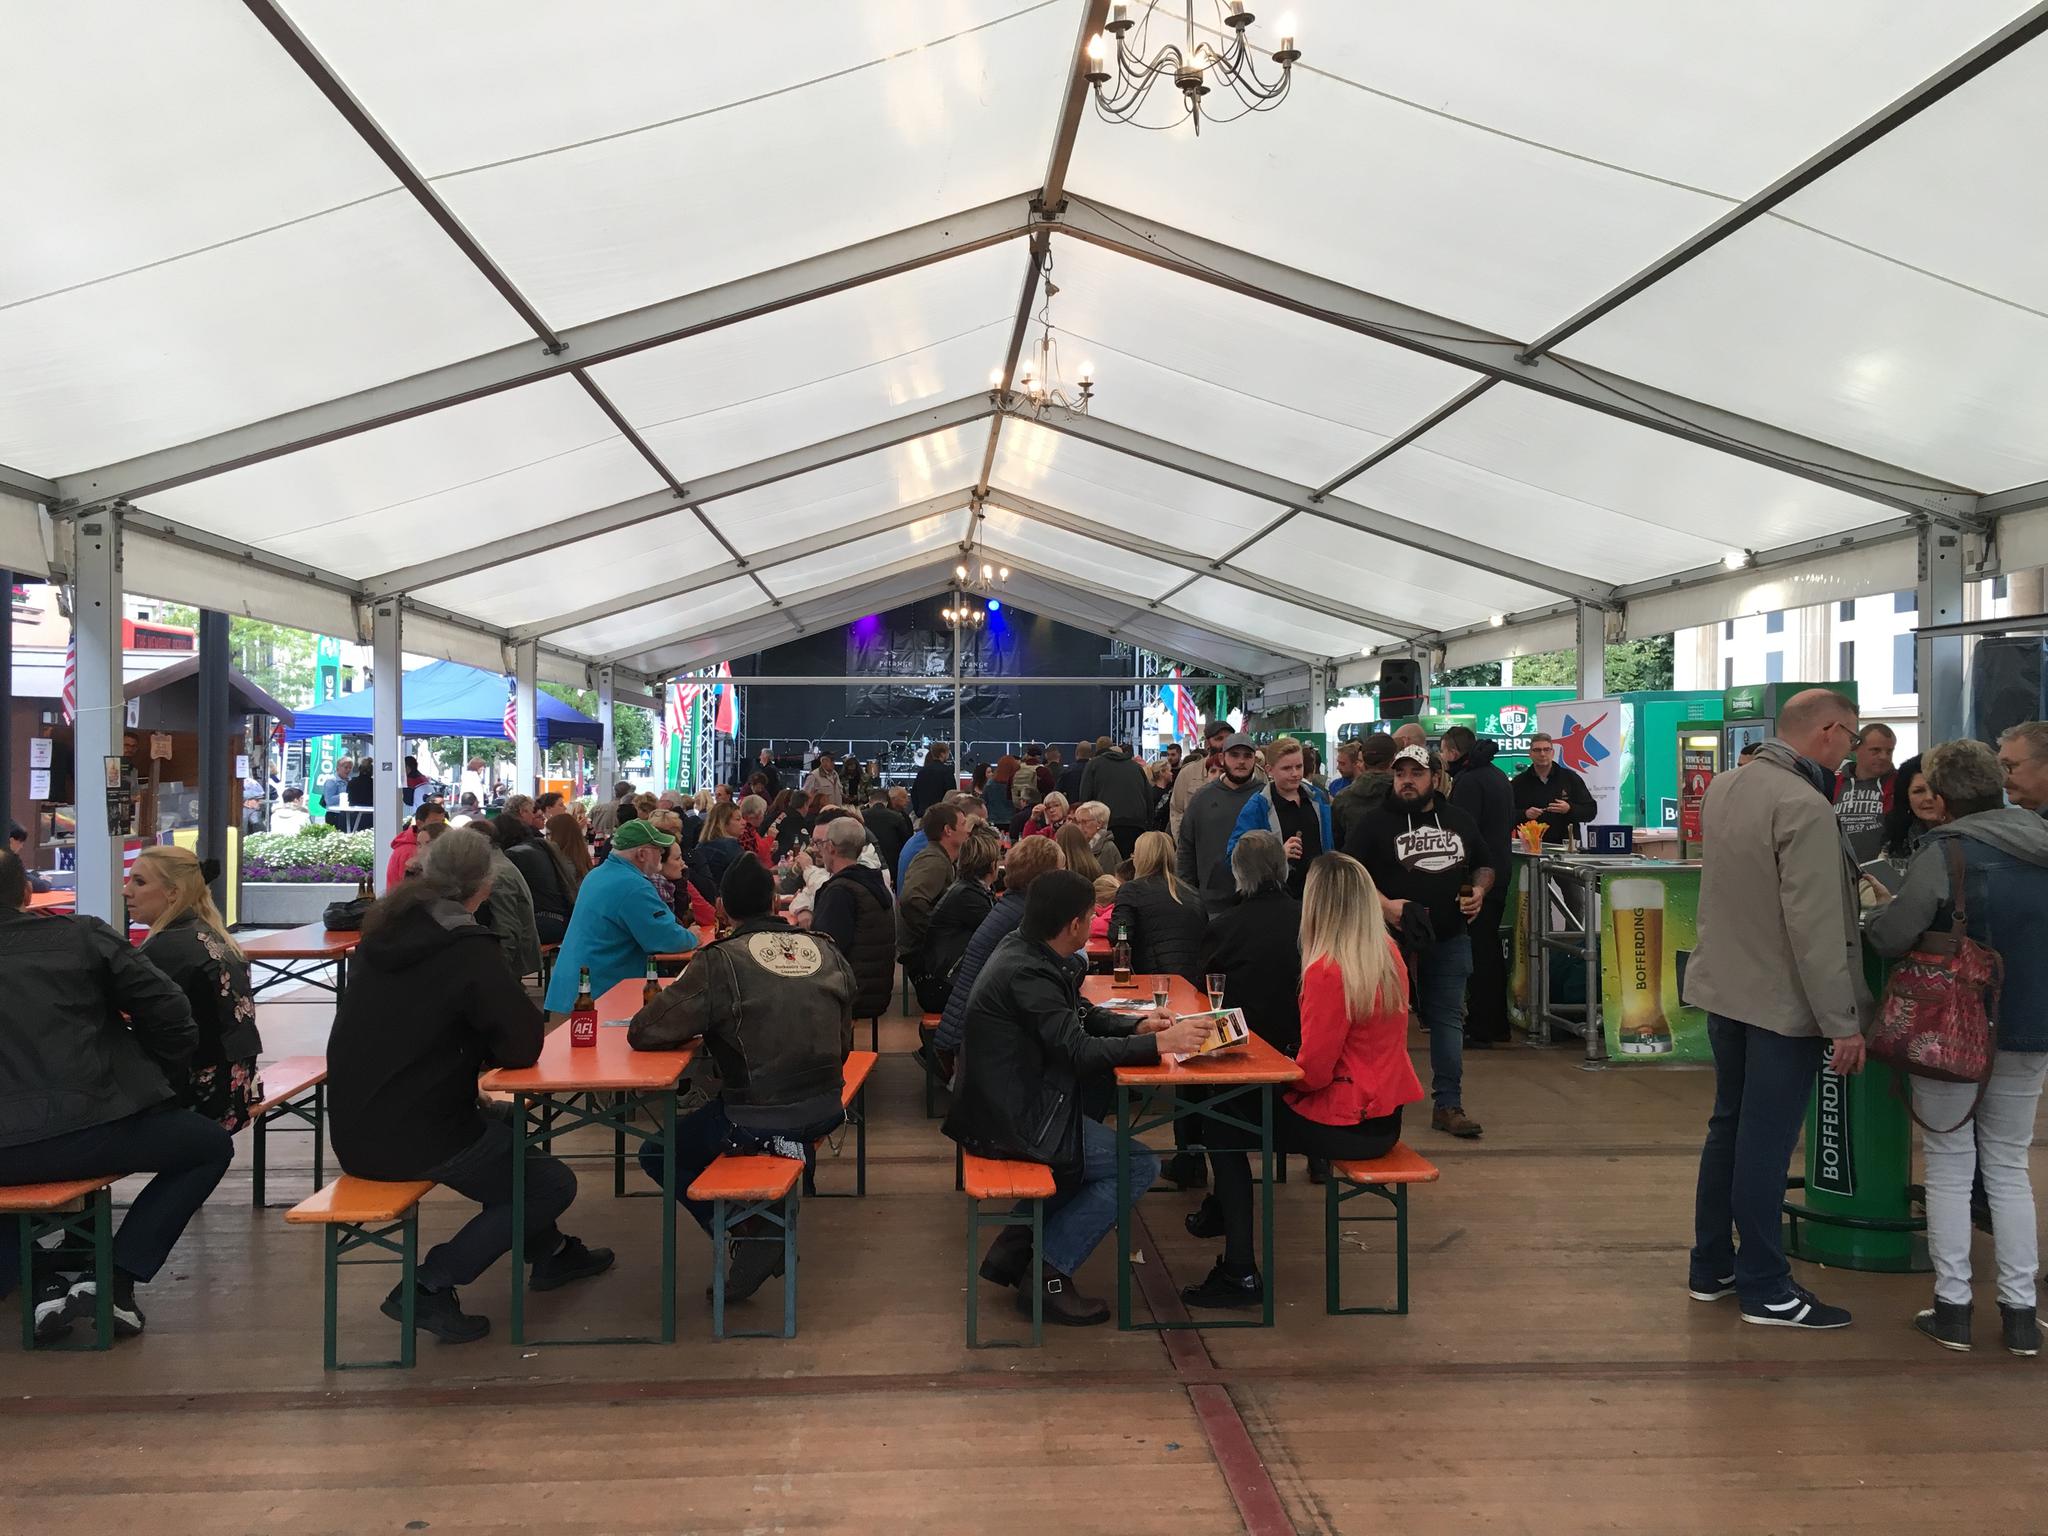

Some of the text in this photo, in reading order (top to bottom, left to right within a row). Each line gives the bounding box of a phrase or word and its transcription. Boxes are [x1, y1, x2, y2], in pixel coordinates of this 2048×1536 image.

[1842, 789, 1880, 801] DENIM
[1833, 801, 1883, 814] UTFITTER
[1398, 830, 1456, 855] Petrol
[1612, 833, 1623, 847] 51
[1634, 907, 1647, 990] BOFFERDING
[574, 1022, 594, 1034] AFL
